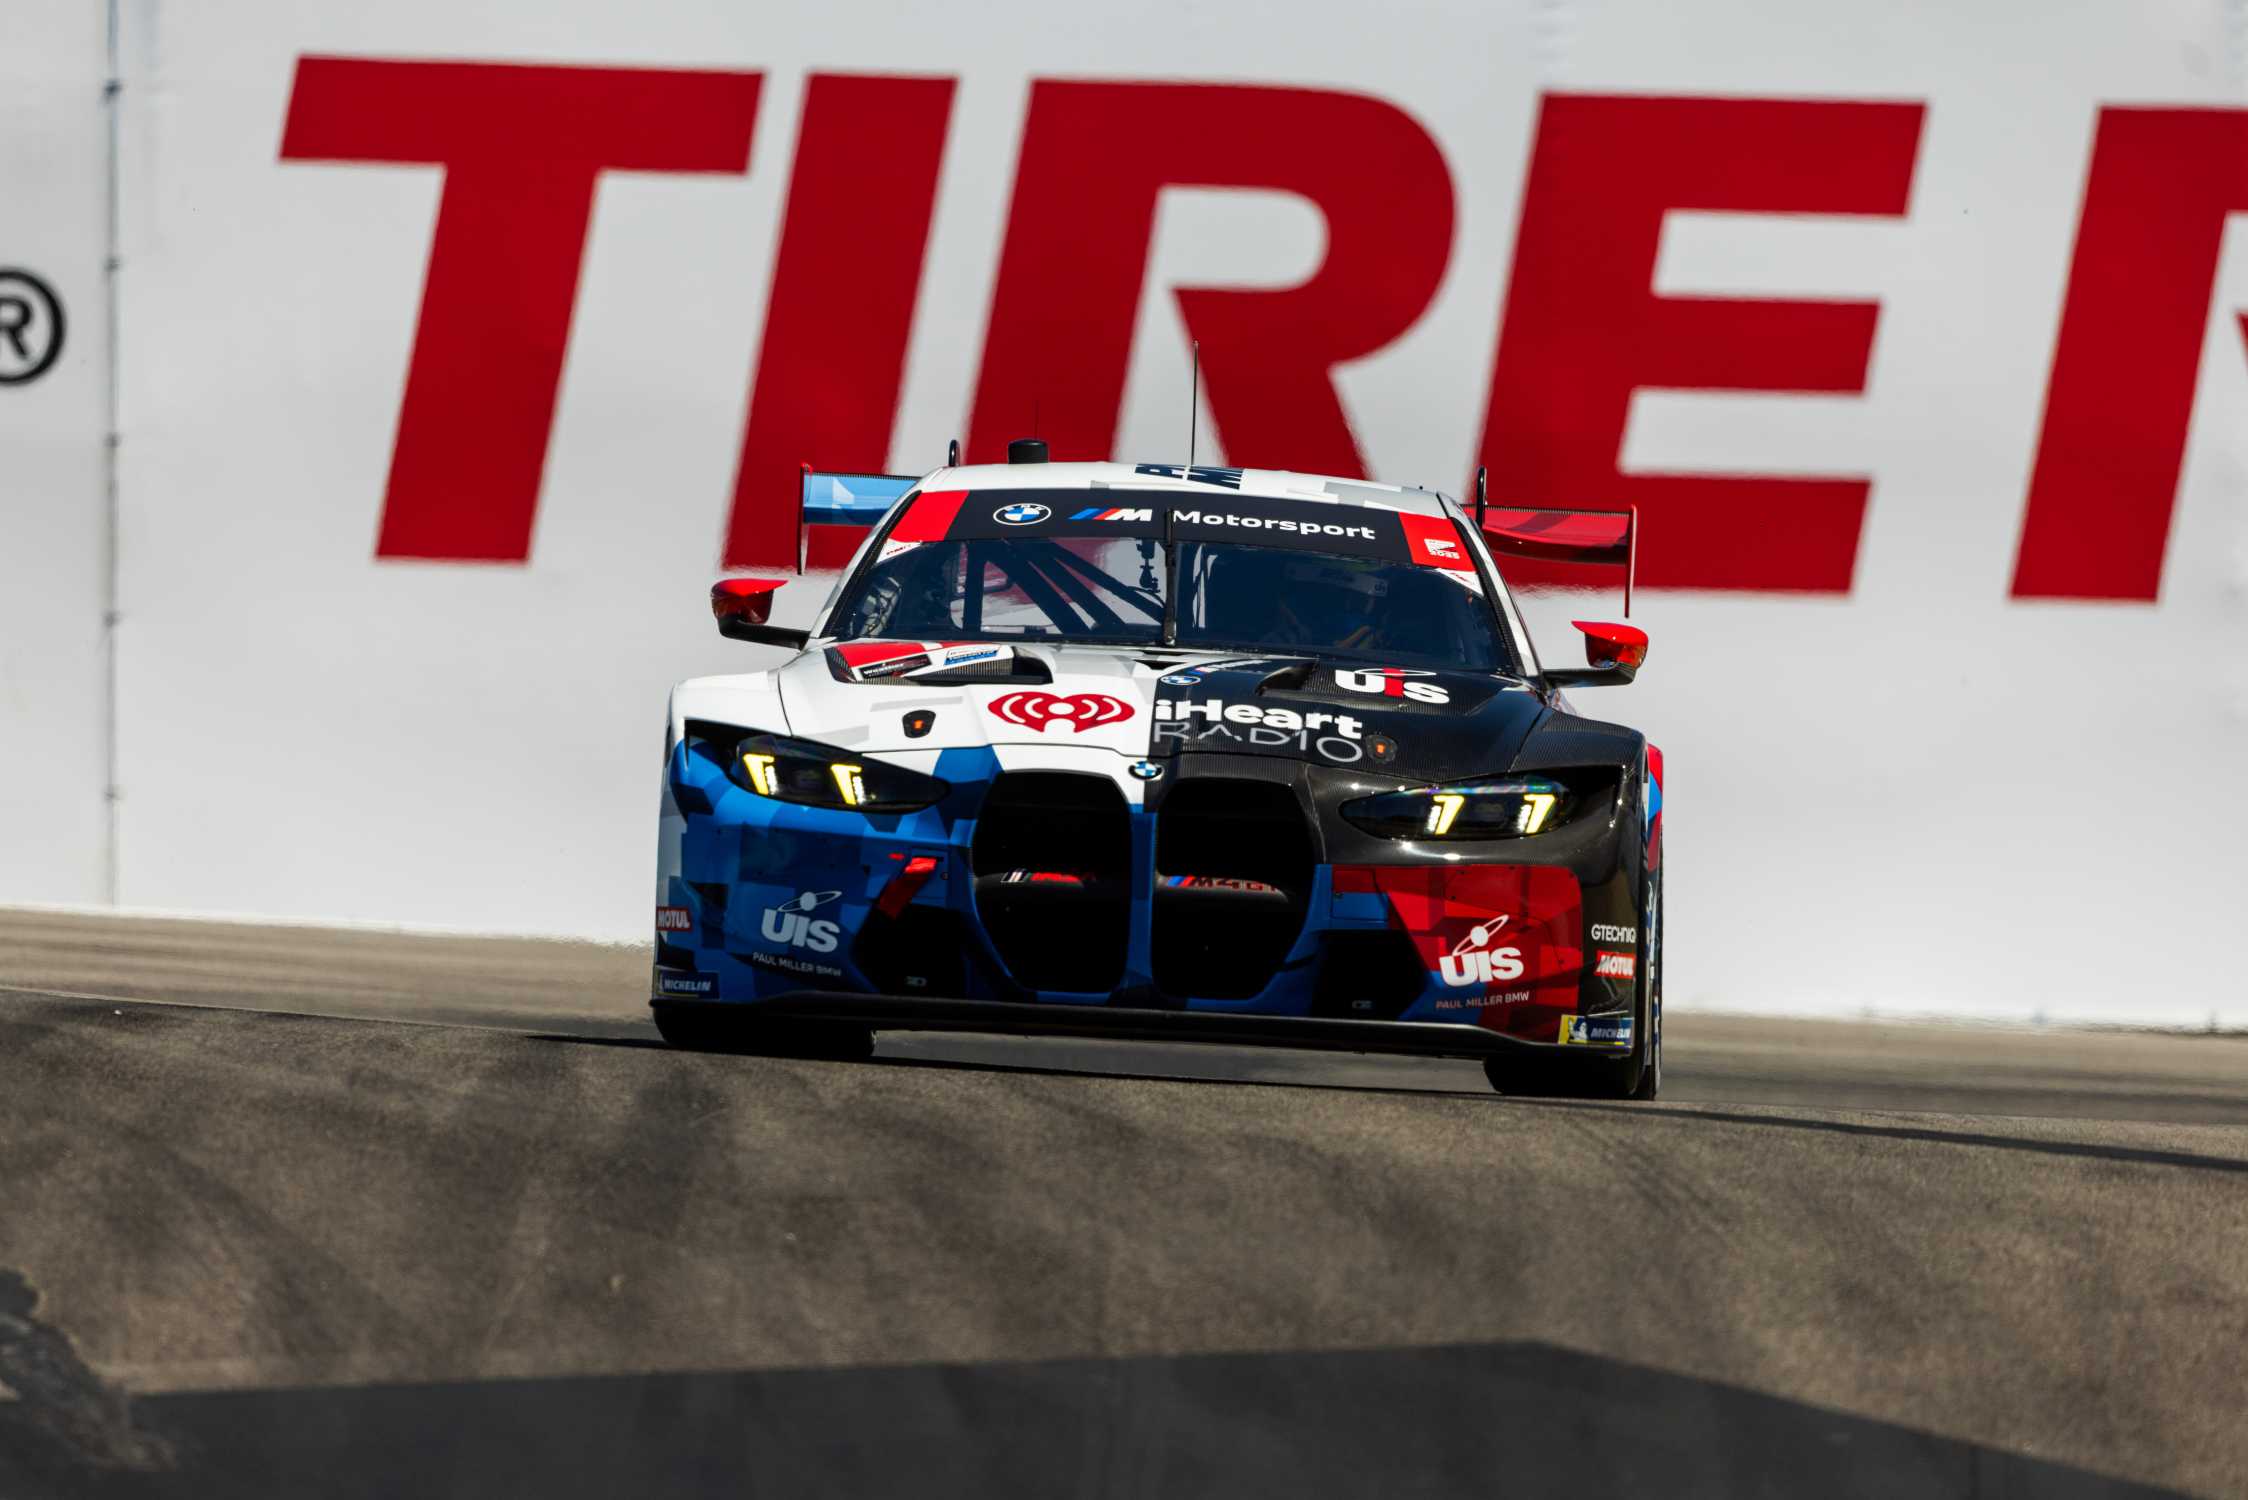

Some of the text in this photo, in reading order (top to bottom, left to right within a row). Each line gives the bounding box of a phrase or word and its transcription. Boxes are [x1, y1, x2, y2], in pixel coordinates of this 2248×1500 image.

[279, 54, 1927, 597] TIRE
[1173, 510, 1376, 540] Motorsport
[1155, 699, 1363, 740] iHeart
[1153, 721, 1364, 763] RADIO
[657, 910, 690, 929] MOTUL
[752, 951, 777, 967] PAUL
[778, 957, 815, 973] MILLER
[1596, 954, 1634, 977] MOTUL
[663, 978, 712, 992] MICHELIN
[1435, 991, 1530, 1010] PAUL MILLER BMW
